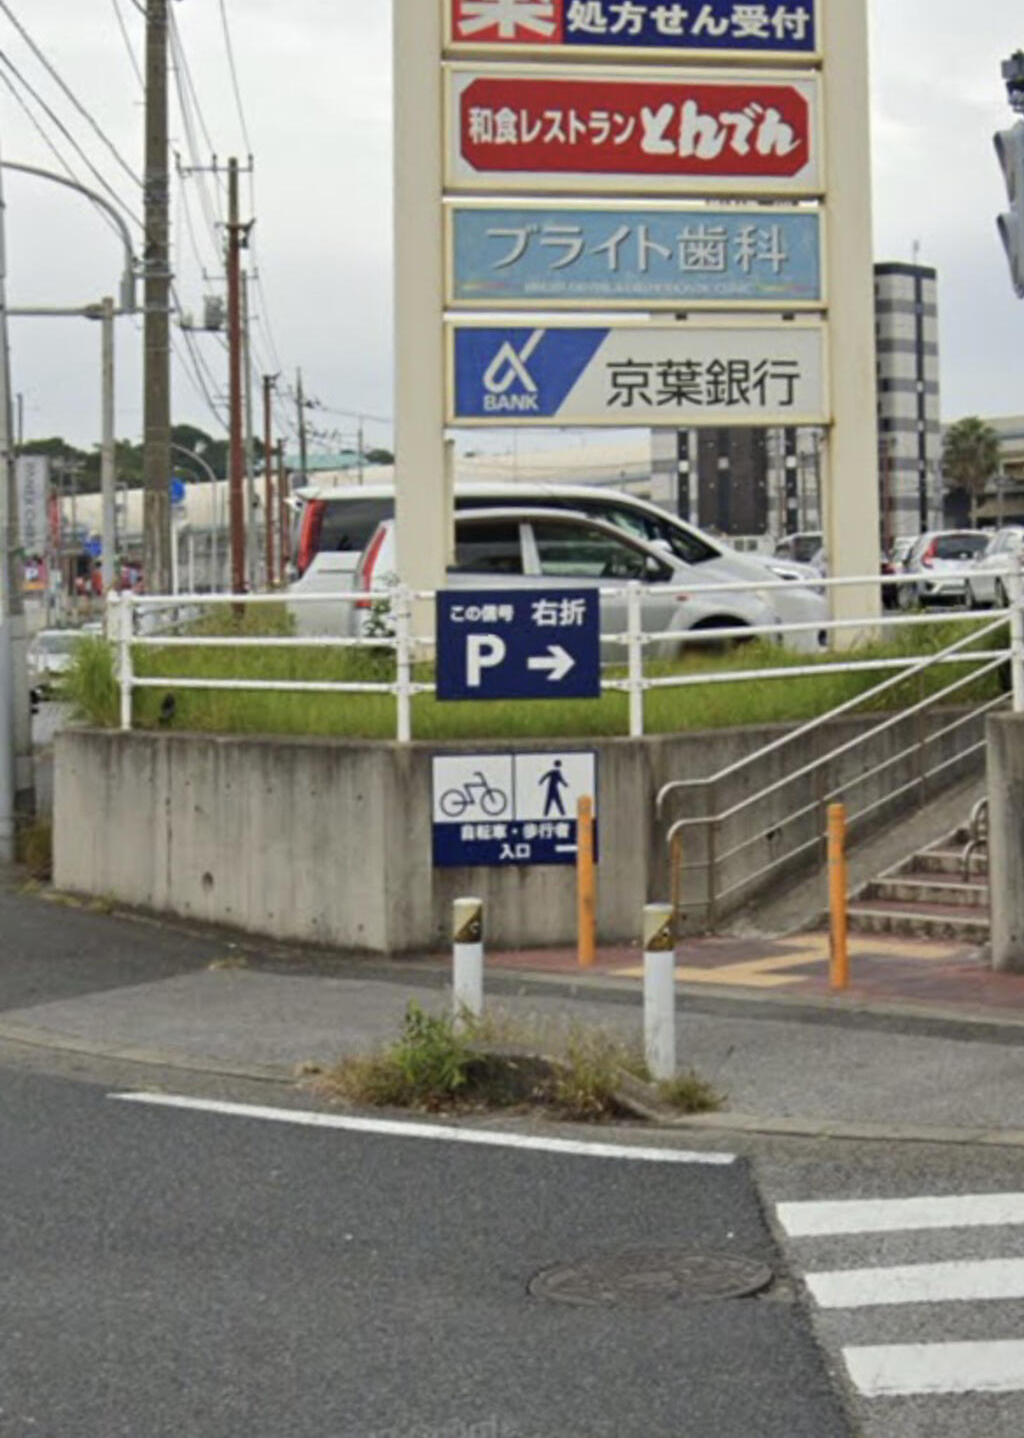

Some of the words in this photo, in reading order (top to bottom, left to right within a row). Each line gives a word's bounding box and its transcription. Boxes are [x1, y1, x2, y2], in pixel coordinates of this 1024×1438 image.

[467, 105, 636, 147] 和食レストラン
[640, 98, 802, 161] とんでん
[485, 222, 788, 274] ブライト歯科
[483, 393, 539, 412] BANK
[605, 358, 801, 409] 京葉銀行
[530, 597, 586, 626] 右折
[466, 633, 507, 688] P
[499, 842, 532, 860] 入口
